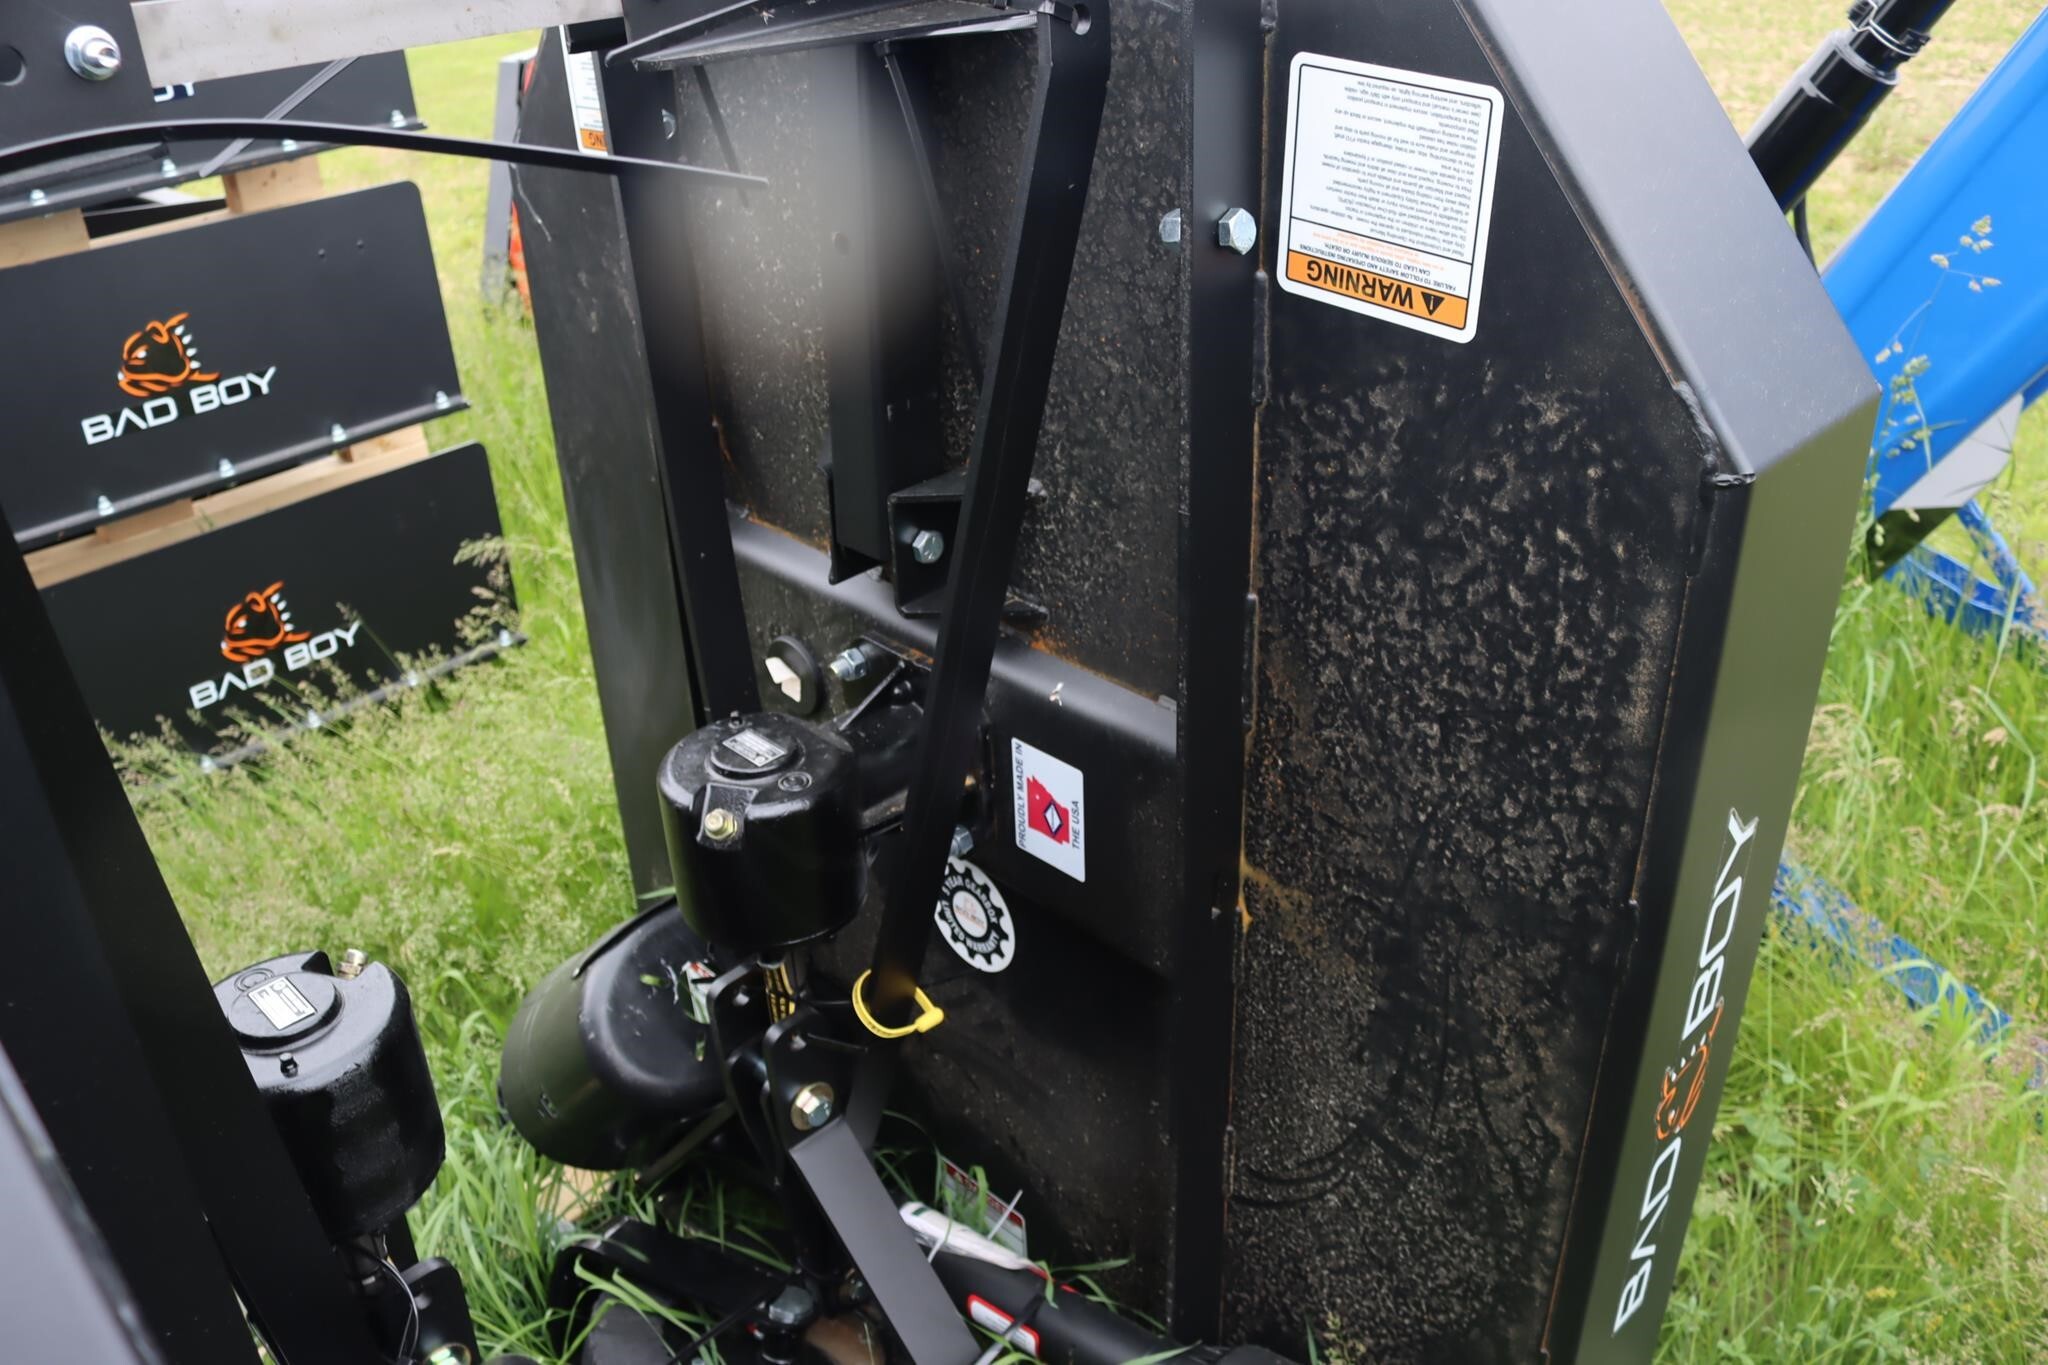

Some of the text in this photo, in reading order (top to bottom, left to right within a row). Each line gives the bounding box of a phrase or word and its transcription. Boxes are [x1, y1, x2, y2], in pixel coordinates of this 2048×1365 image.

[1299, 243, 1335, 258] INSTRUCTIONS
[1351, 249, 1369, 259] INJURY
[1337, 254, 1365, 266] OPERATING
[1367, 262, 1377, 270] AND
[1370, 255, 1393, 266] SERIOUS
[1379, 265, 1398, 275] SAFETY
[1403, 263, 1417, 272] LEAD
[1418, 268, 1430, 276] CAN
[1400, 271, 1422, 282] FOLLOW
[1306, 258, 1414, 309] WARNING
[1432, 280, 1455, 291] FAILURE
[81, 366, 277, 445] BAD BOY
[189, 619, 361, 710] BAD BOY
[1014, 742, 1026, 848] PROUDLY MADE IN
[1071, 801, 1080, 850] THE USA
[944, 875, 964, 890] YEAR
[965, 878, 998, 924] GEARBOX
[941, 899, 965, 941] LIMITED
[965, 929, 1000, 954] WARRANTY
[1613, 807, 1759, 1334] BAD BOY
